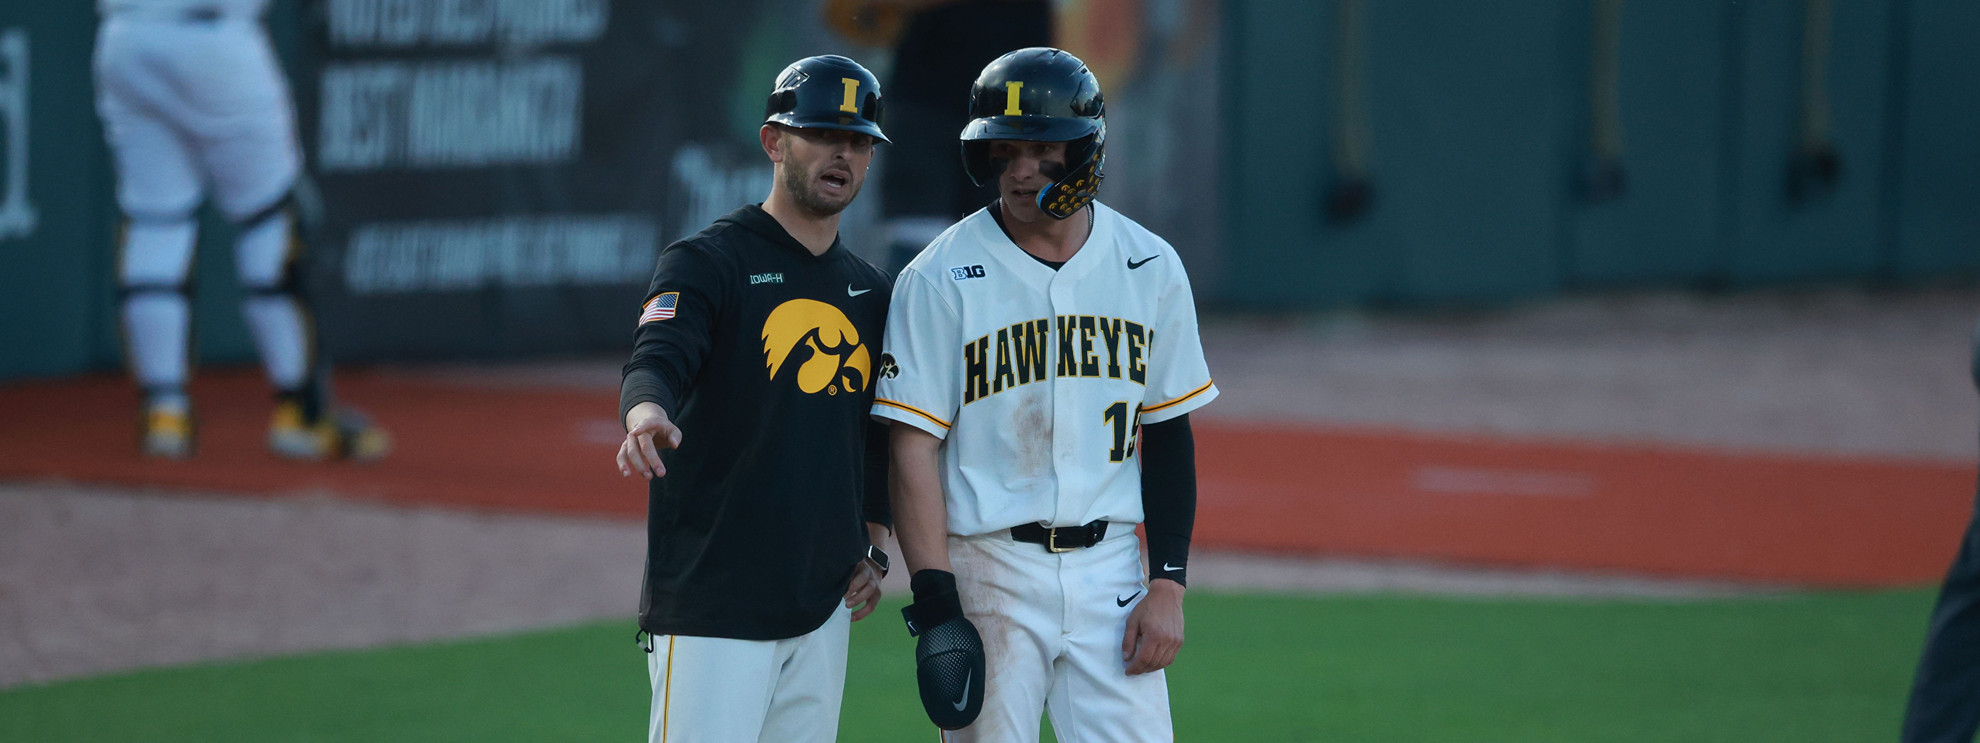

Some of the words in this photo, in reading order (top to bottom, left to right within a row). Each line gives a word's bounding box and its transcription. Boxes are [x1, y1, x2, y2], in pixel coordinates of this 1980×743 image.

[840, 77, 860, 114] I
[1004, 81, 1024, 116] I
[963, 314, 1155, 407] HAWKEYE
